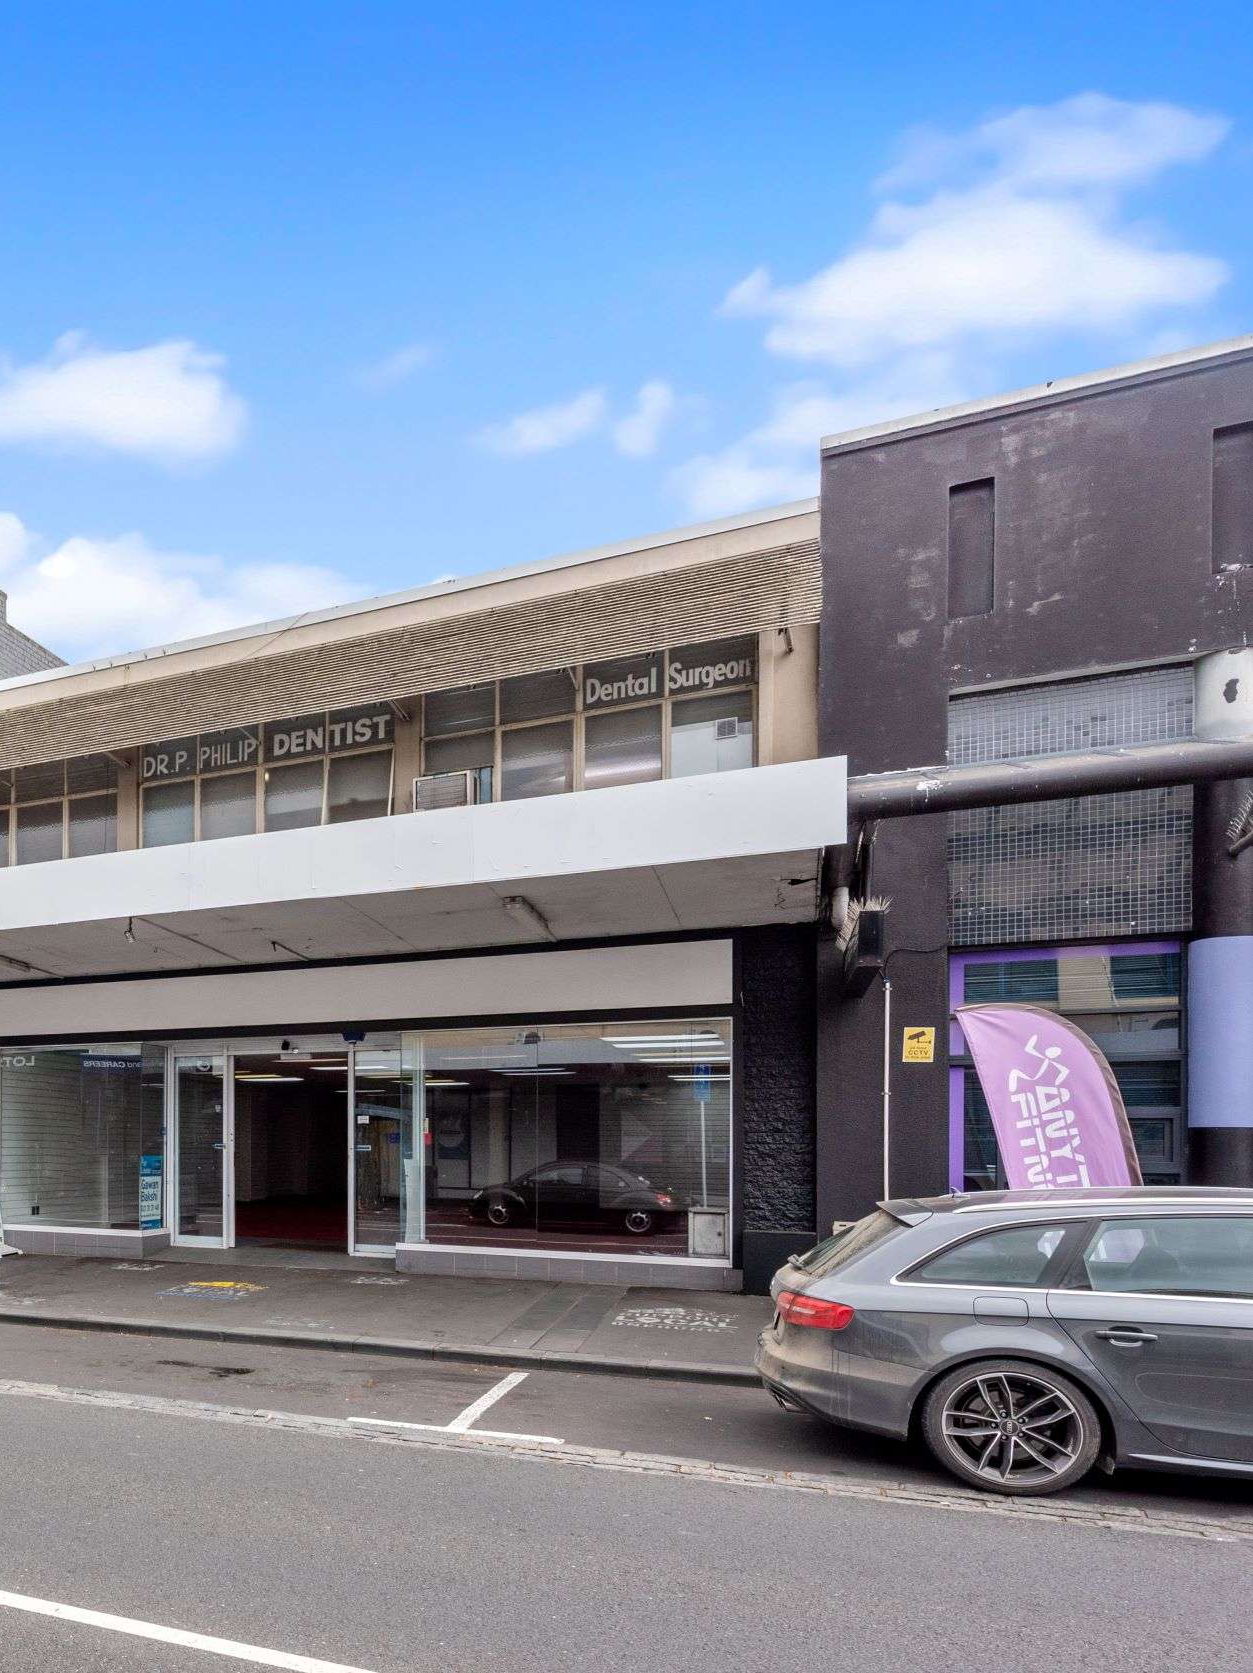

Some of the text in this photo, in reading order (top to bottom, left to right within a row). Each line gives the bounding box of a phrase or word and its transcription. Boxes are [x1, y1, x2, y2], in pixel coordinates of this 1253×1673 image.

[585, 659, 752, 704] Dental Surgeon
[199, 739, 260, 769] PHILIP
[273, 714, 392, 757] DENTIST
[1010, 1092, 1056, 1189] FITN
[1035, 1085, 1091, 1189] ANYT
